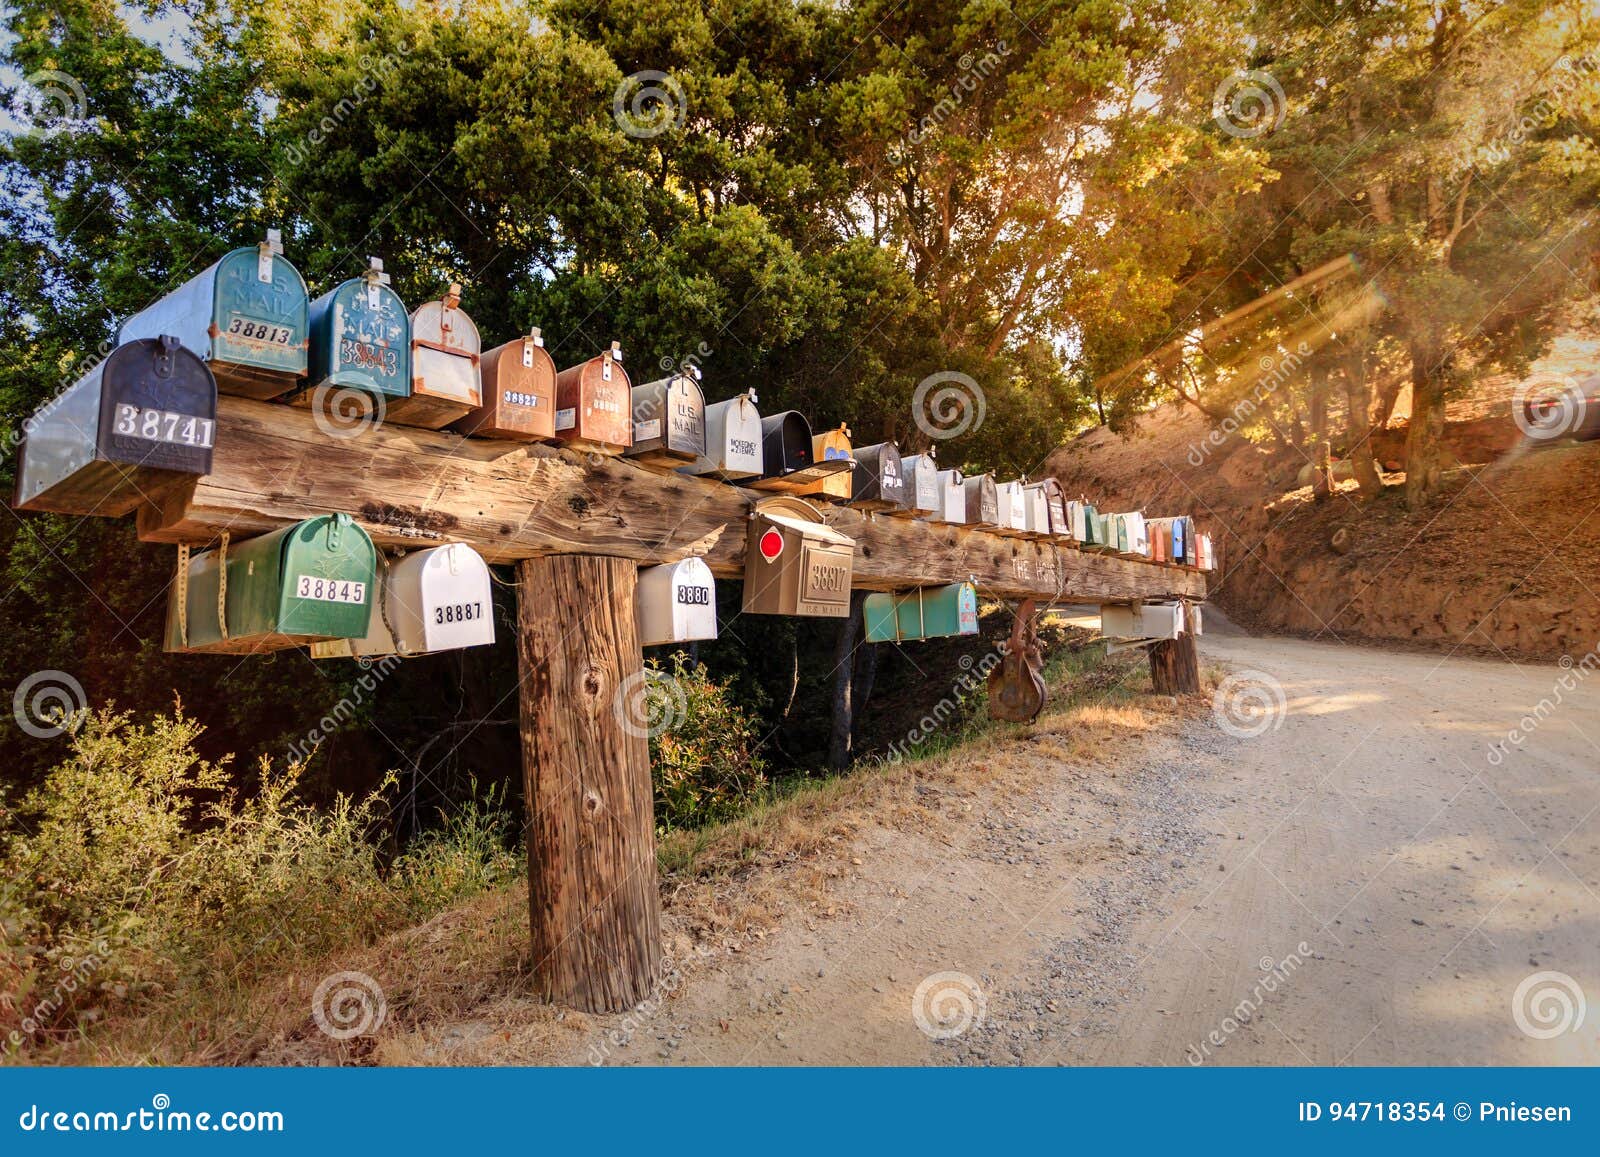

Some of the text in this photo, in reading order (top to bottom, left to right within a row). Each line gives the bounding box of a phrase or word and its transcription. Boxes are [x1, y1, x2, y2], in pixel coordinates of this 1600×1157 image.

[229, 319, 290, 344] 38813
[341, 338, 397, 377] 38843
[505, 390, 538, 407] 38827
[118, 405, 213, 448] 38741
[674, 418, 700, 436] MAIL
[301, 577, 363, 602] 38845
[812, 564, 847, 593] 38817
[679, 586, 709, 605] 3880
[436, 603, 482, 624] 38887
